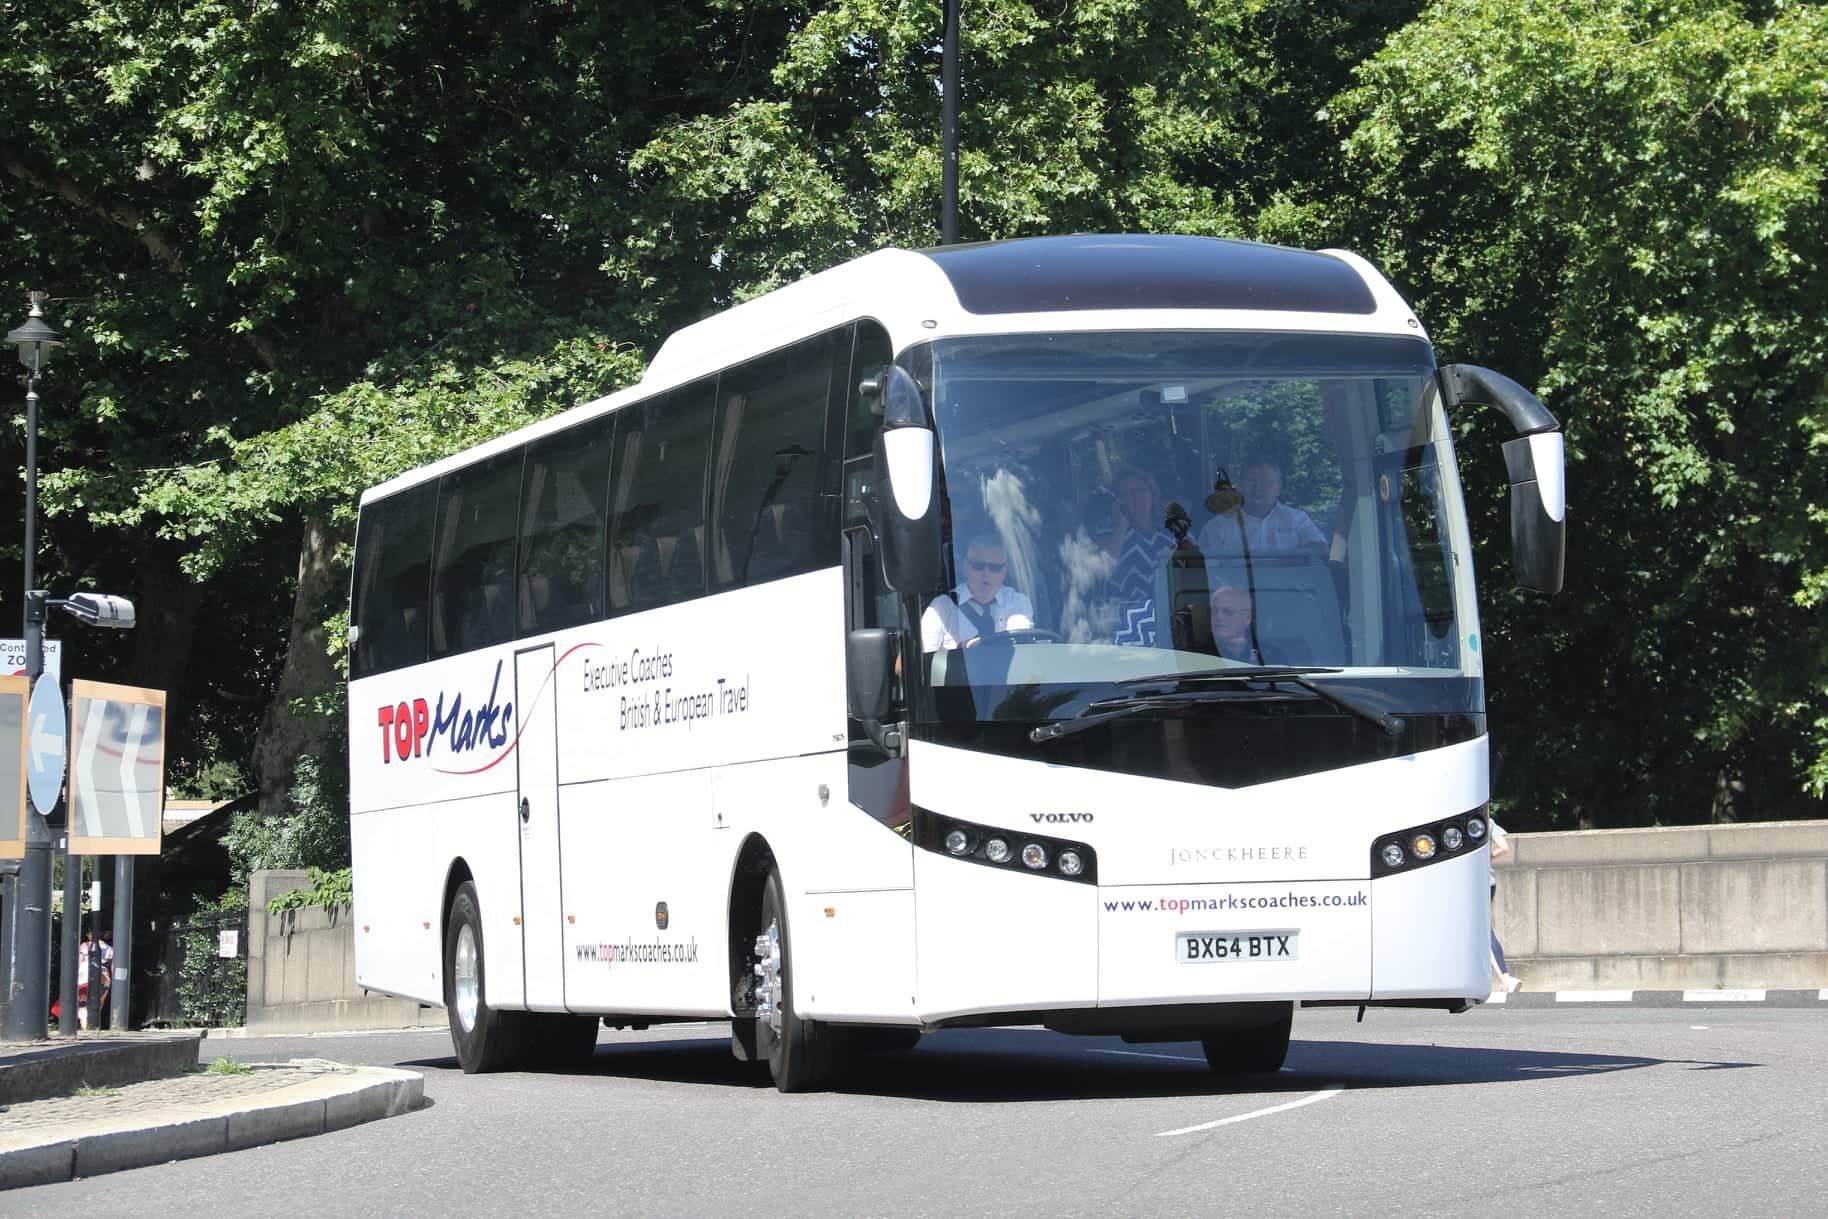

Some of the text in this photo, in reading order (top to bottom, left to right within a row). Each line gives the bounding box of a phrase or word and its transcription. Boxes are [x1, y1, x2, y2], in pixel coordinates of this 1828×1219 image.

[0, 643, 56, 652] Conted
[584, 645, 673, 692] Executive Coaches
[620, 673, 749, 732] British & European Travel
[1029, 813, 1094, 823] VOLVO
[1170, 846, 1308, 865] JONCKHEERE
[1104, 891, 1367, 915] www.topmarkscoaches.co.uk
[576, 936, 698, 971] www.topmarkscoaches.co.uk
[1187, 936, 1290, 959] BX64 BTX
